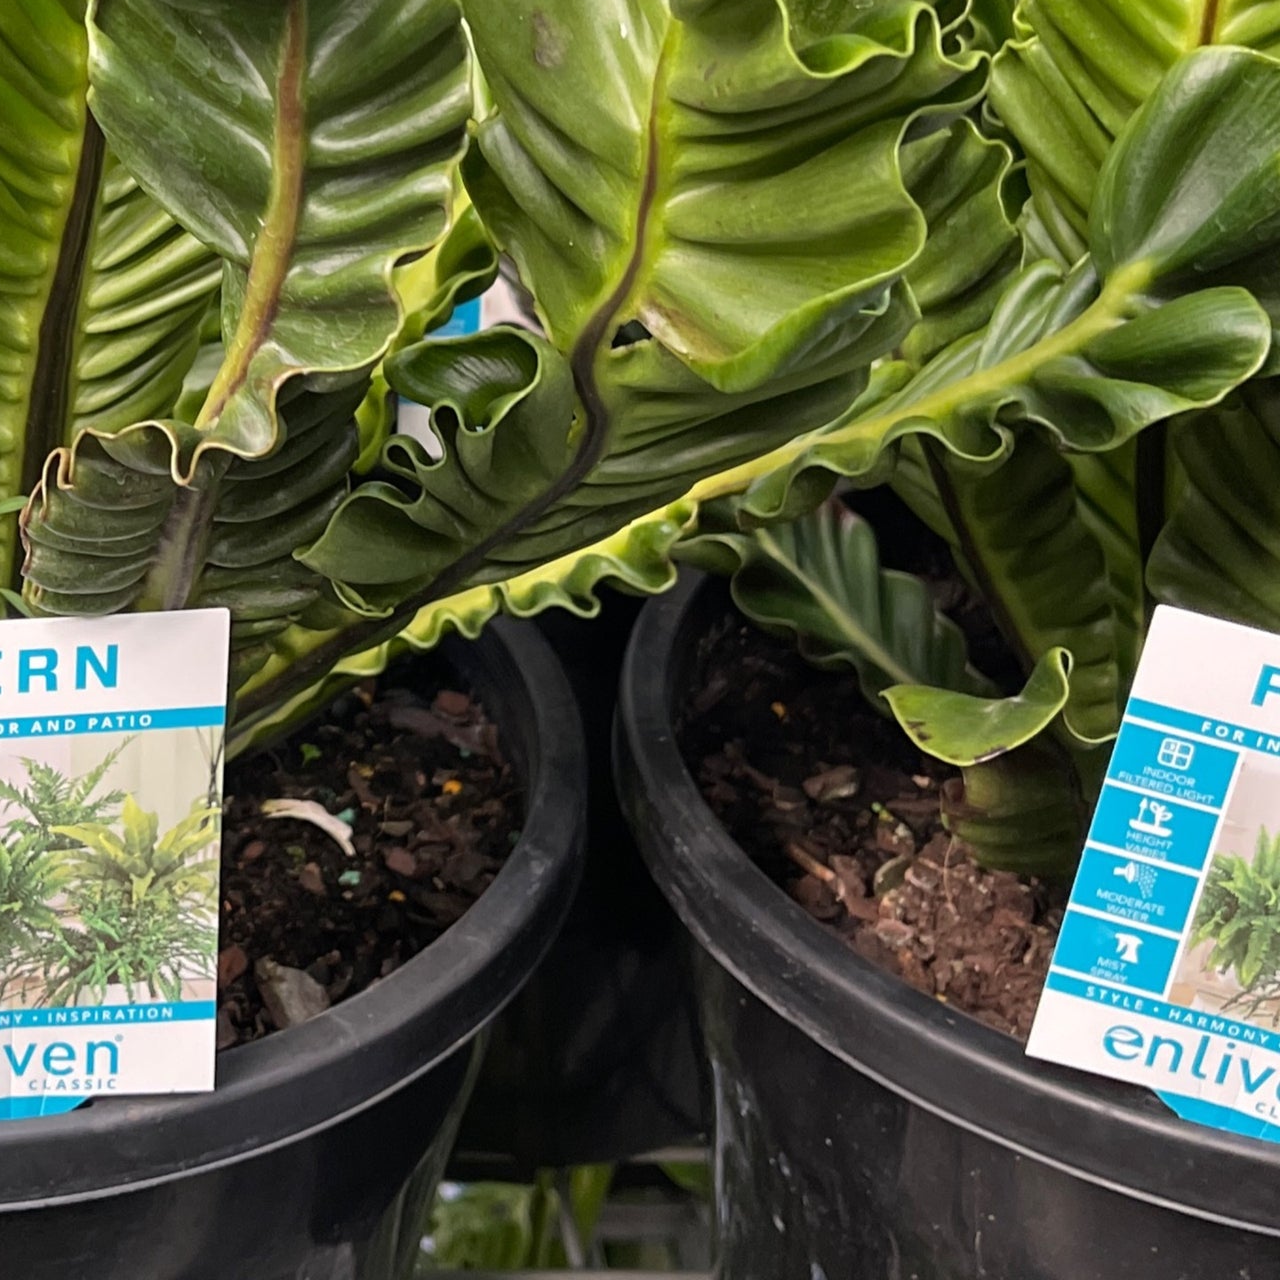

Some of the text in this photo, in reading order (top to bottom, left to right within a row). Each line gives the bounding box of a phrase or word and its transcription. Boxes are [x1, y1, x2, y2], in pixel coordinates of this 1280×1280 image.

[31, 718, 76, 734] AND
[88, 714, 152, 729] PATIO
[1201, 721, 1245, 743] FOR
[1142, 766, 1196, 787] INDOOR
[1118, 771, 1215, 805] FILTERED LIGHT
[1126, 830, 1173, 850] HEIGHT
[1096, 888, 1165, 916] MODERATE
[1106, 902, 1149, 922] WATER
[1097, 956, 1127, 972] MIST
[47, 1006, 174, 1024] INSPIRATION
[1086, 985, 1270, 1045] STYLE HARMONY
[1102, 1024, 1280, 1098] enliv
[28, 1077, 117, 1091] CLASSIC
